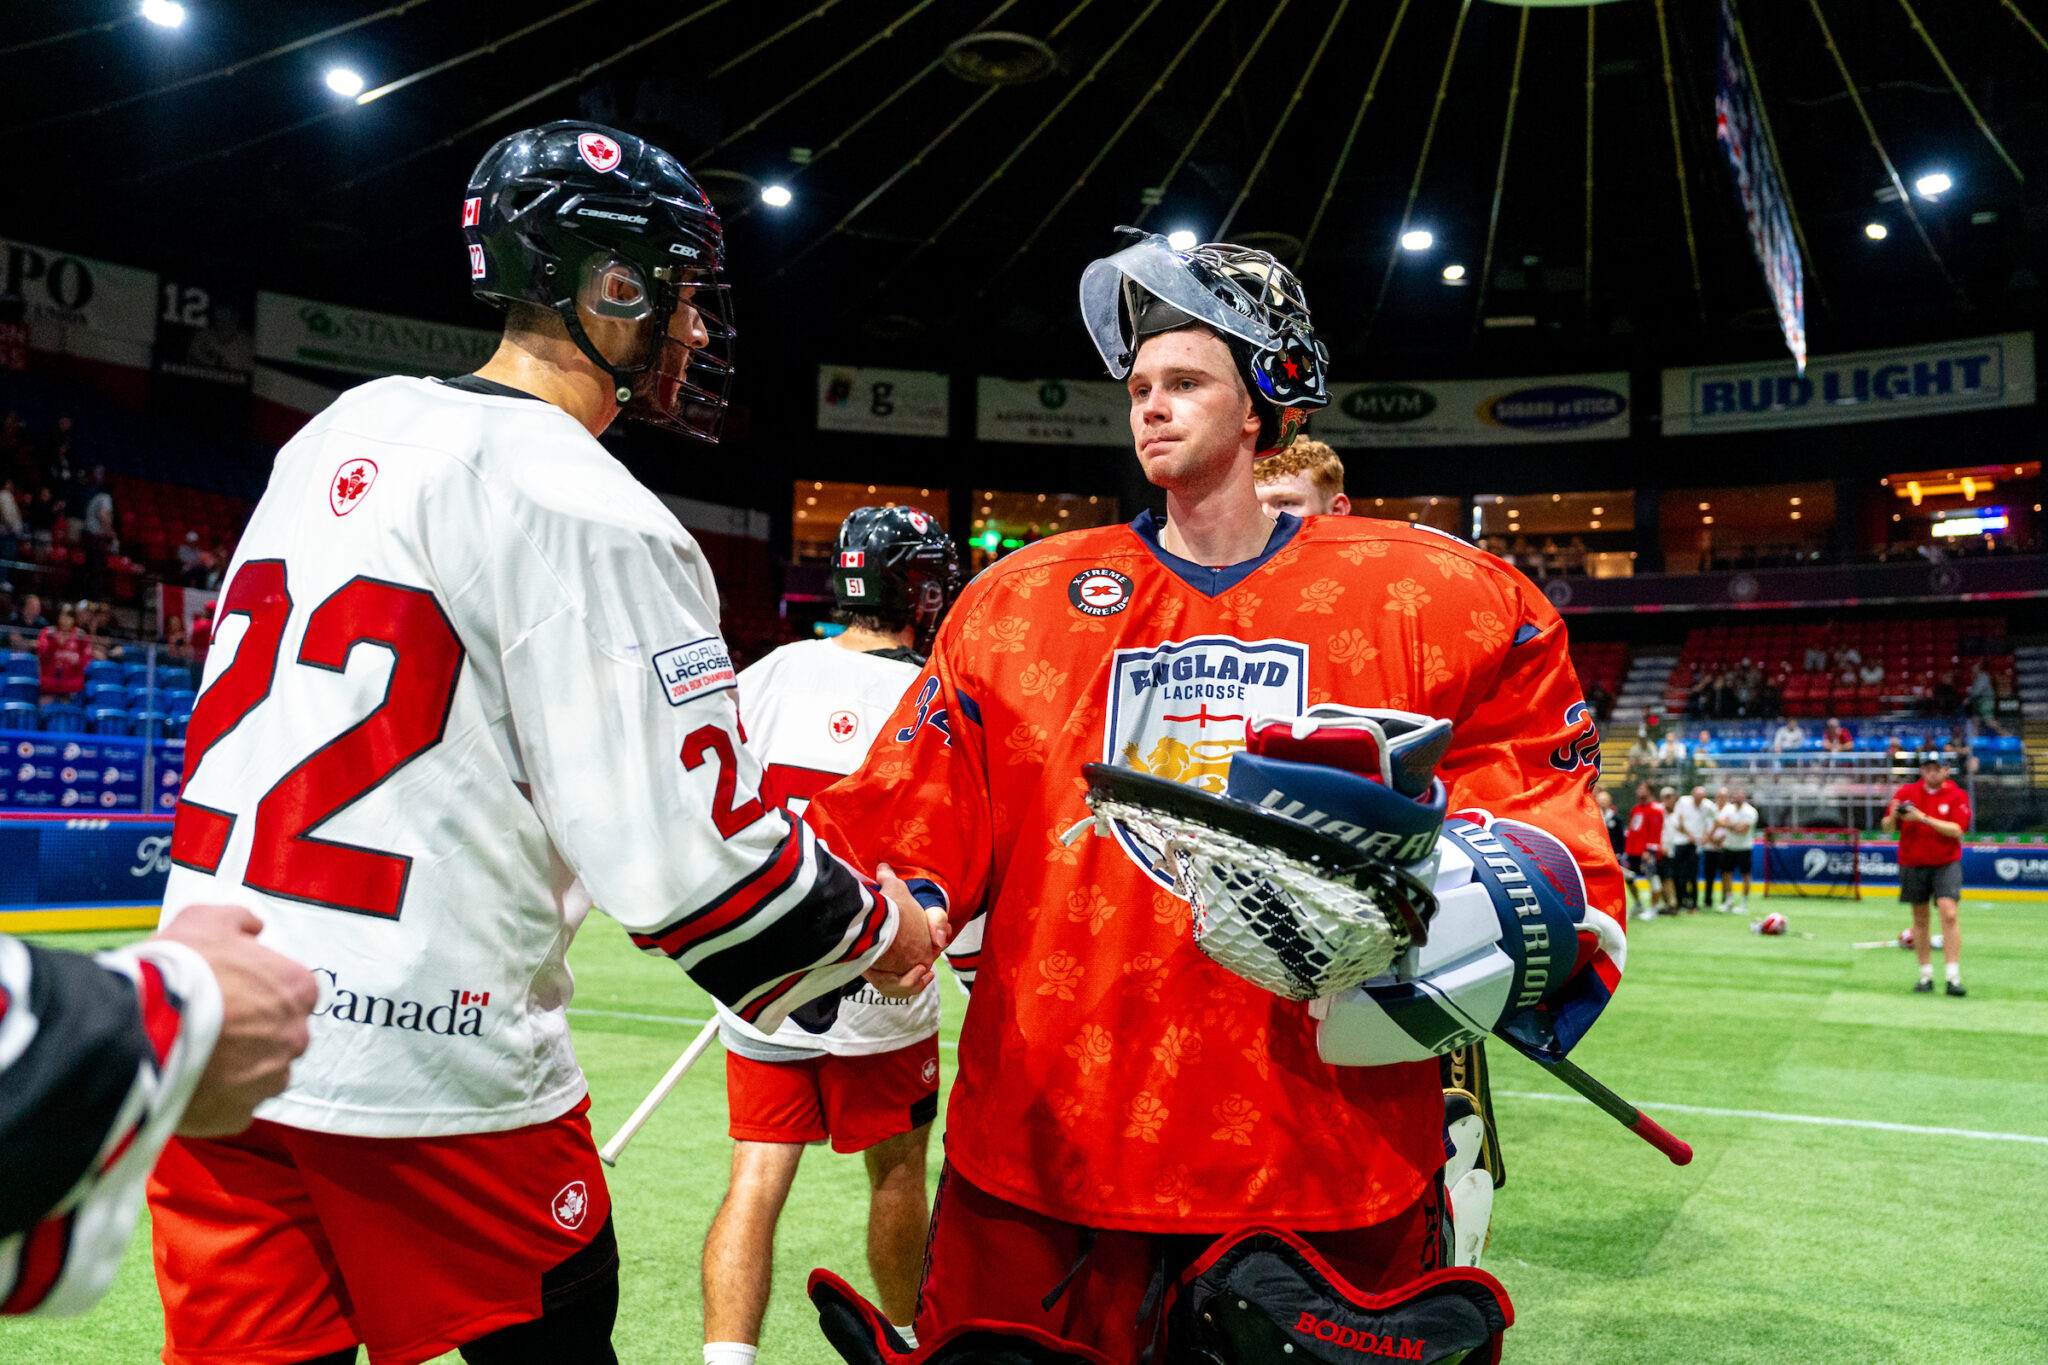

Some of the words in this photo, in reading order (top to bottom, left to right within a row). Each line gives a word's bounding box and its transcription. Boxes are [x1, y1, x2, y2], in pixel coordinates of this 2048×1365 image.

[576, 208, 649, 225] cascade
[163, 281, 211, 328] 12
[1701, 375, 1816, 416] BUD
[1823, 355, 1992, 405] LIGHT
[1352, 394, 1424, 417] MVM
[848, 579, 861, 594] 51
[1071, 568, 1129, 586] X-TREME
[1076, 595, 1130, 616] THREADS
[672, 644, 722, 667] WORLD
[665, 656, 732, 685] LACROSSE
[1129, 653, 1290, 697] ENGLAND
[1163, 684, 1246, 701] LACROSSE
[169, 558, 466, 922] 22
[309, 967, 485, 1038] Canada
[1294, 1311, 1426, 1361] BODDAM
